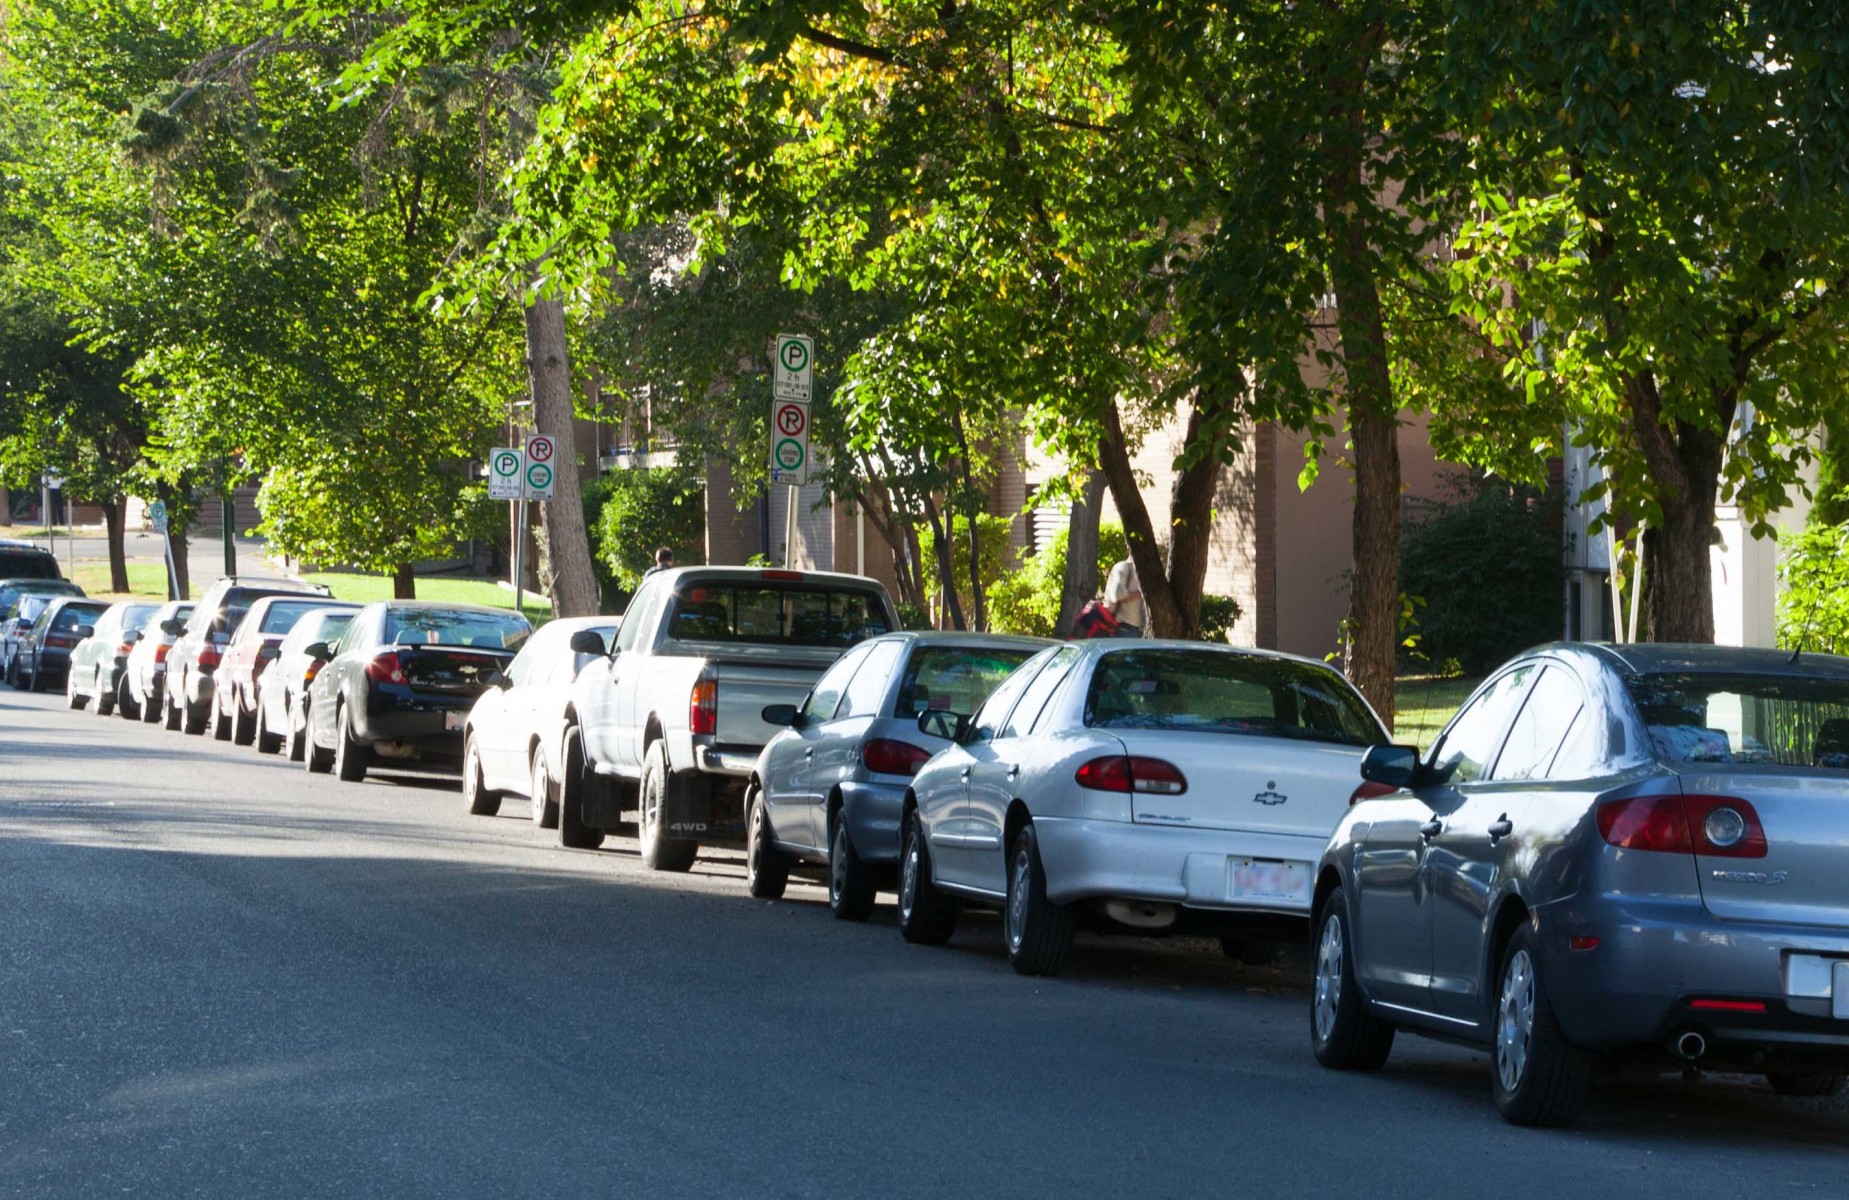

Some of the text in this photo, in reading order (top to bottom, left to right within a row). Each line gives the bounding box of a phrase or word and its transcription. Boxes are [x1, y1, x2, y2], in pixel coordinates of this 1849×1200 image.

[788, 346, 802, 365] P
[787, 372, 800, 382] 2 h
[785, 410, 799, 429] P
[536, 442, 548, 456] P
[780, 449, 798, 457] LOADING
[502, 457, 514, 472] P
[783, 456, 796, 464] ZONE
[670, 822, 708, 832] 4WD
